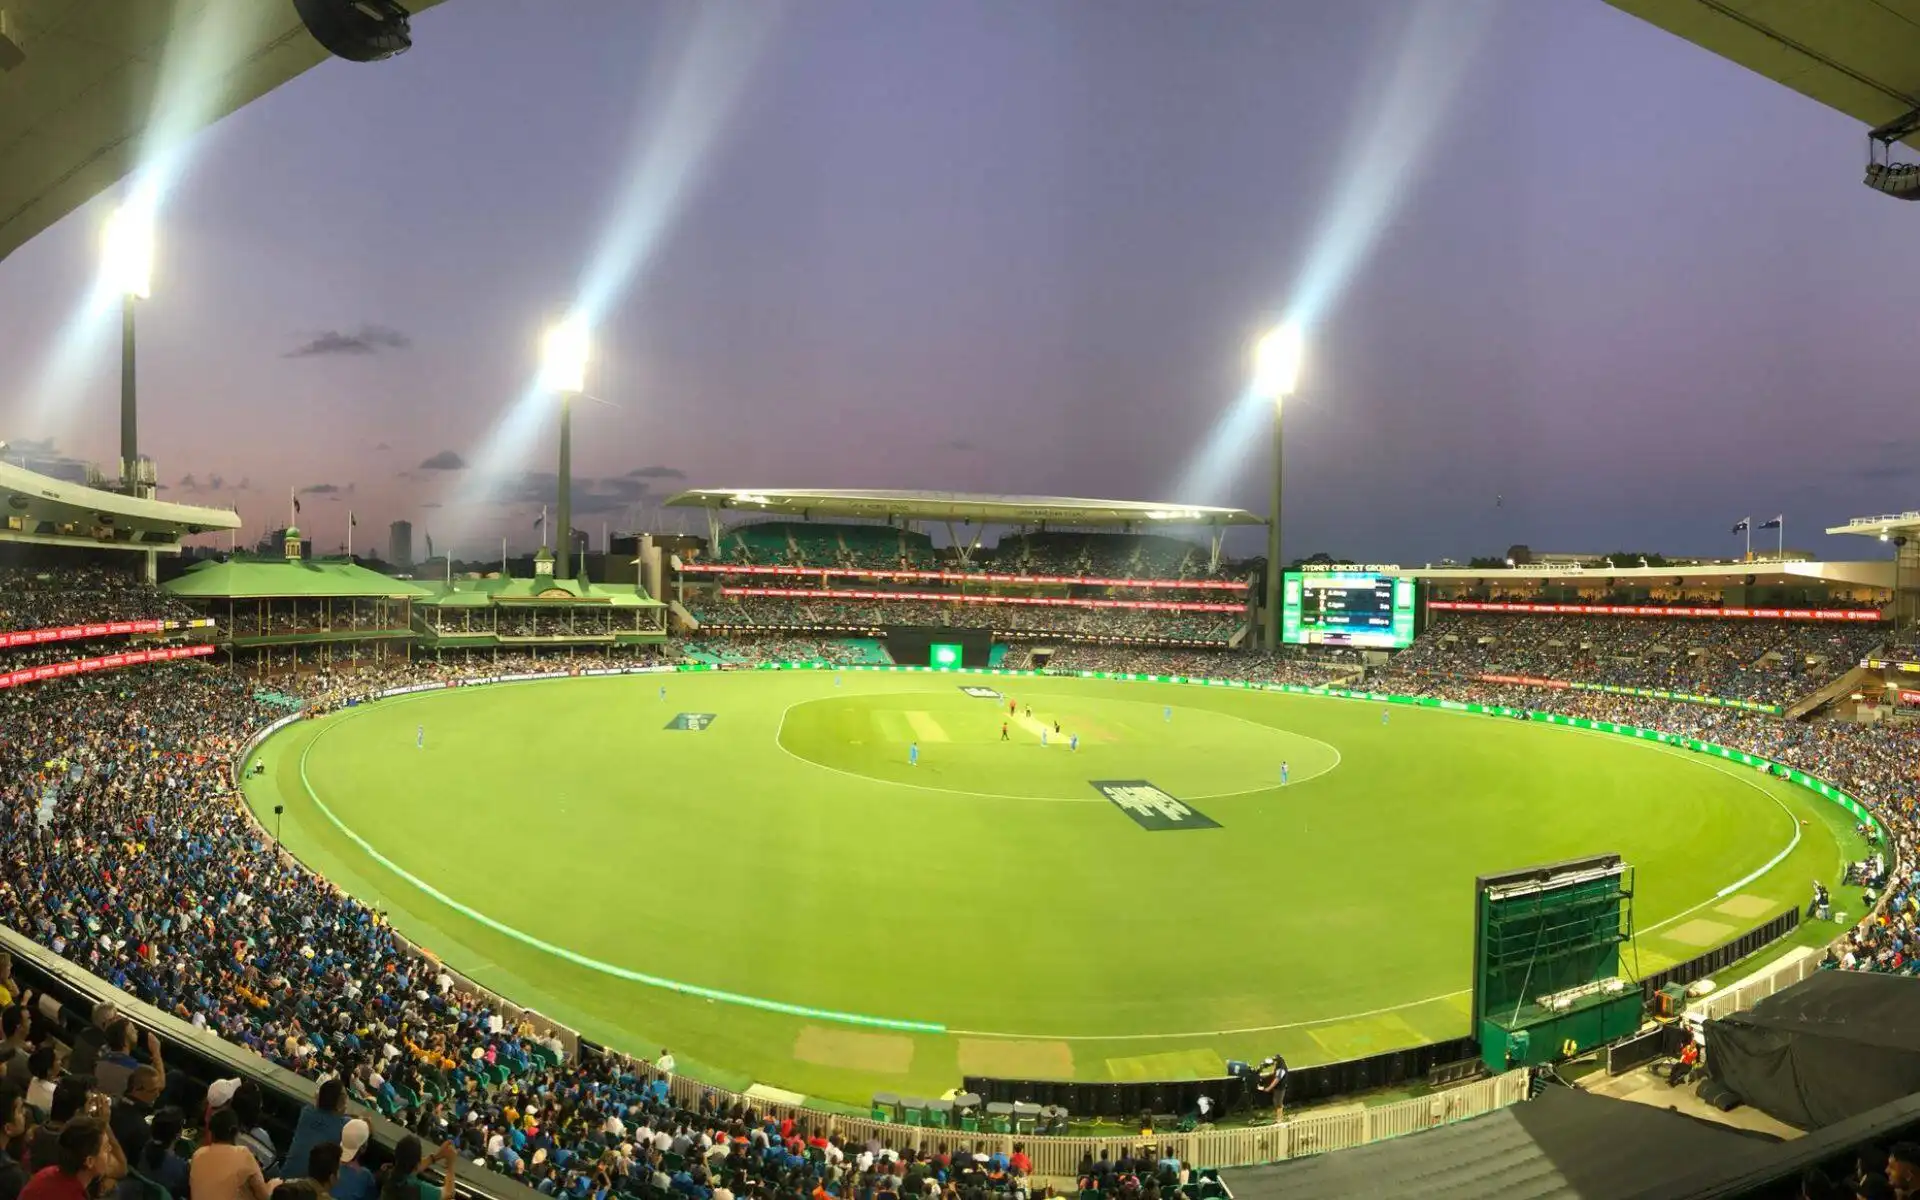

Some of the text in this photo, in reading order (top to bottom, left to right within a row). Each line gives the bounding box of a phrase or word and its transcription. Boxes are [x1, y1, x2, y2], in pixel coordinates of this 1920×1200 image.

[1302, 564, 1399, 572] SYDNEY CRICKET GROUND
